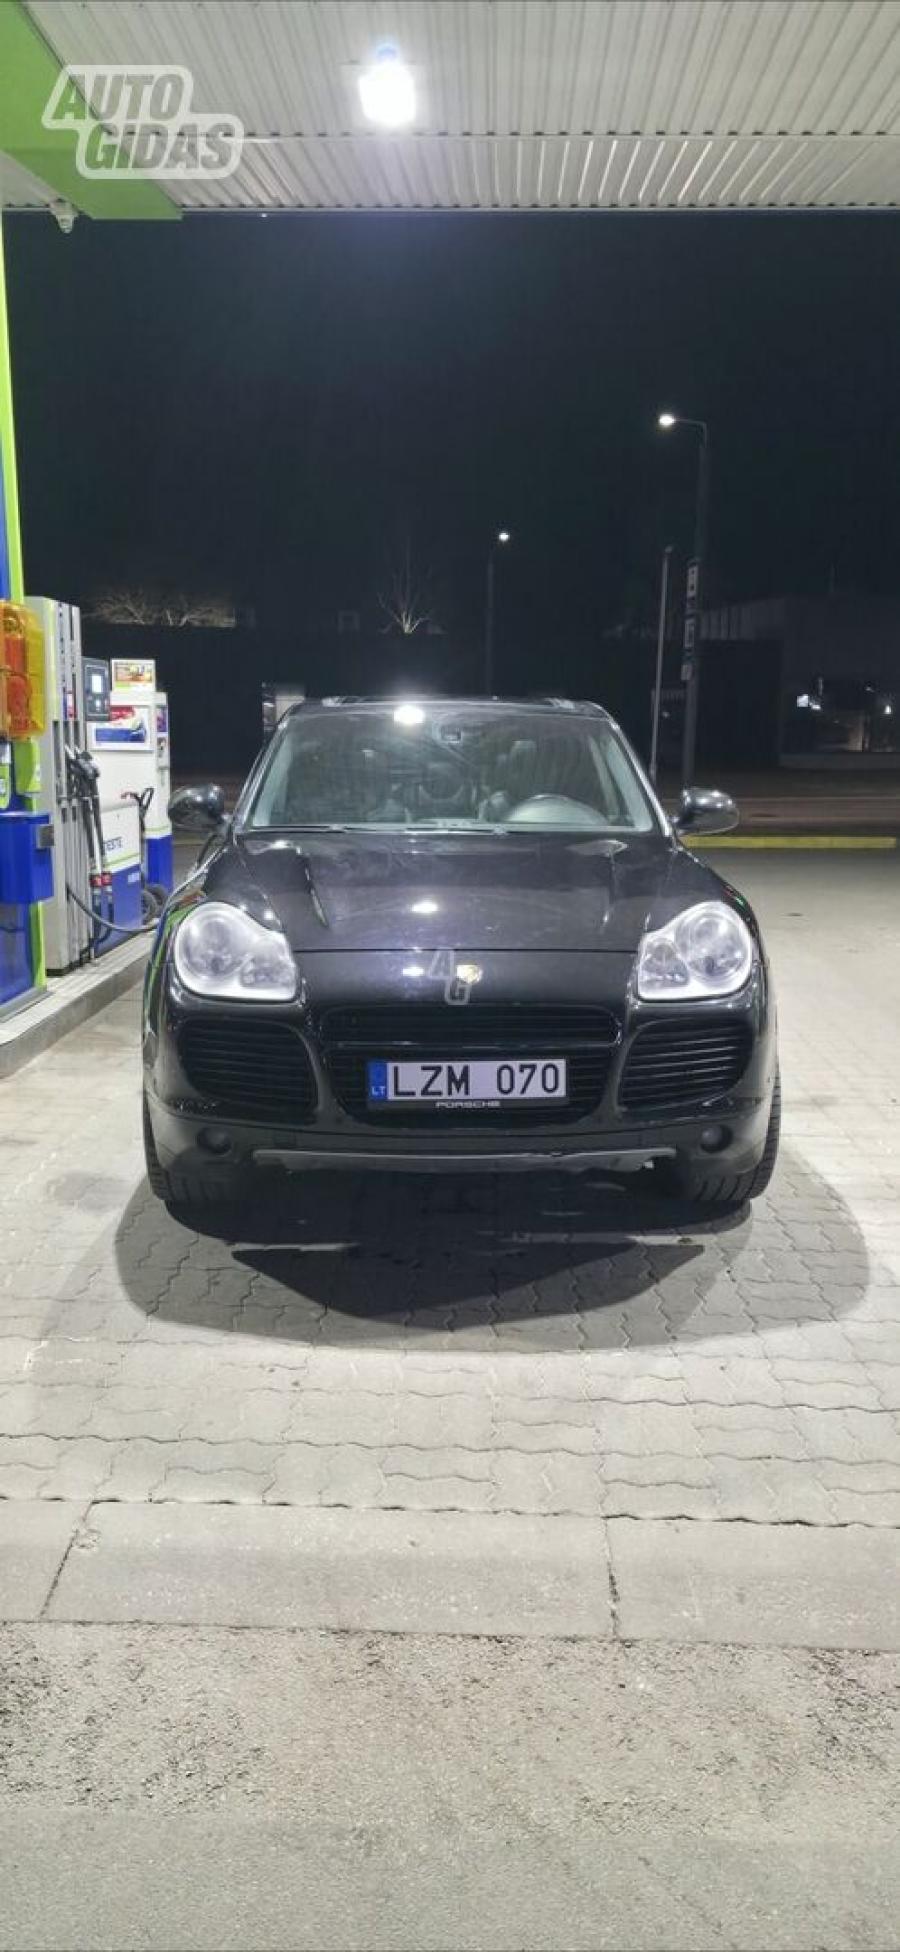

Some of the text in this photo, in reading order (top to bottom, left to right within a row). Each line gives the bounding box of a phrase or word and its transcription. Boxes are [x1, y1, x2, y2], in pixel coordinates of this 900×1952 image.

[393, 1063, 560, 1097] LZM 070
[371, 1086, 386, 1096] LT
[435, 1100, 501, 1109] PORSCHE
